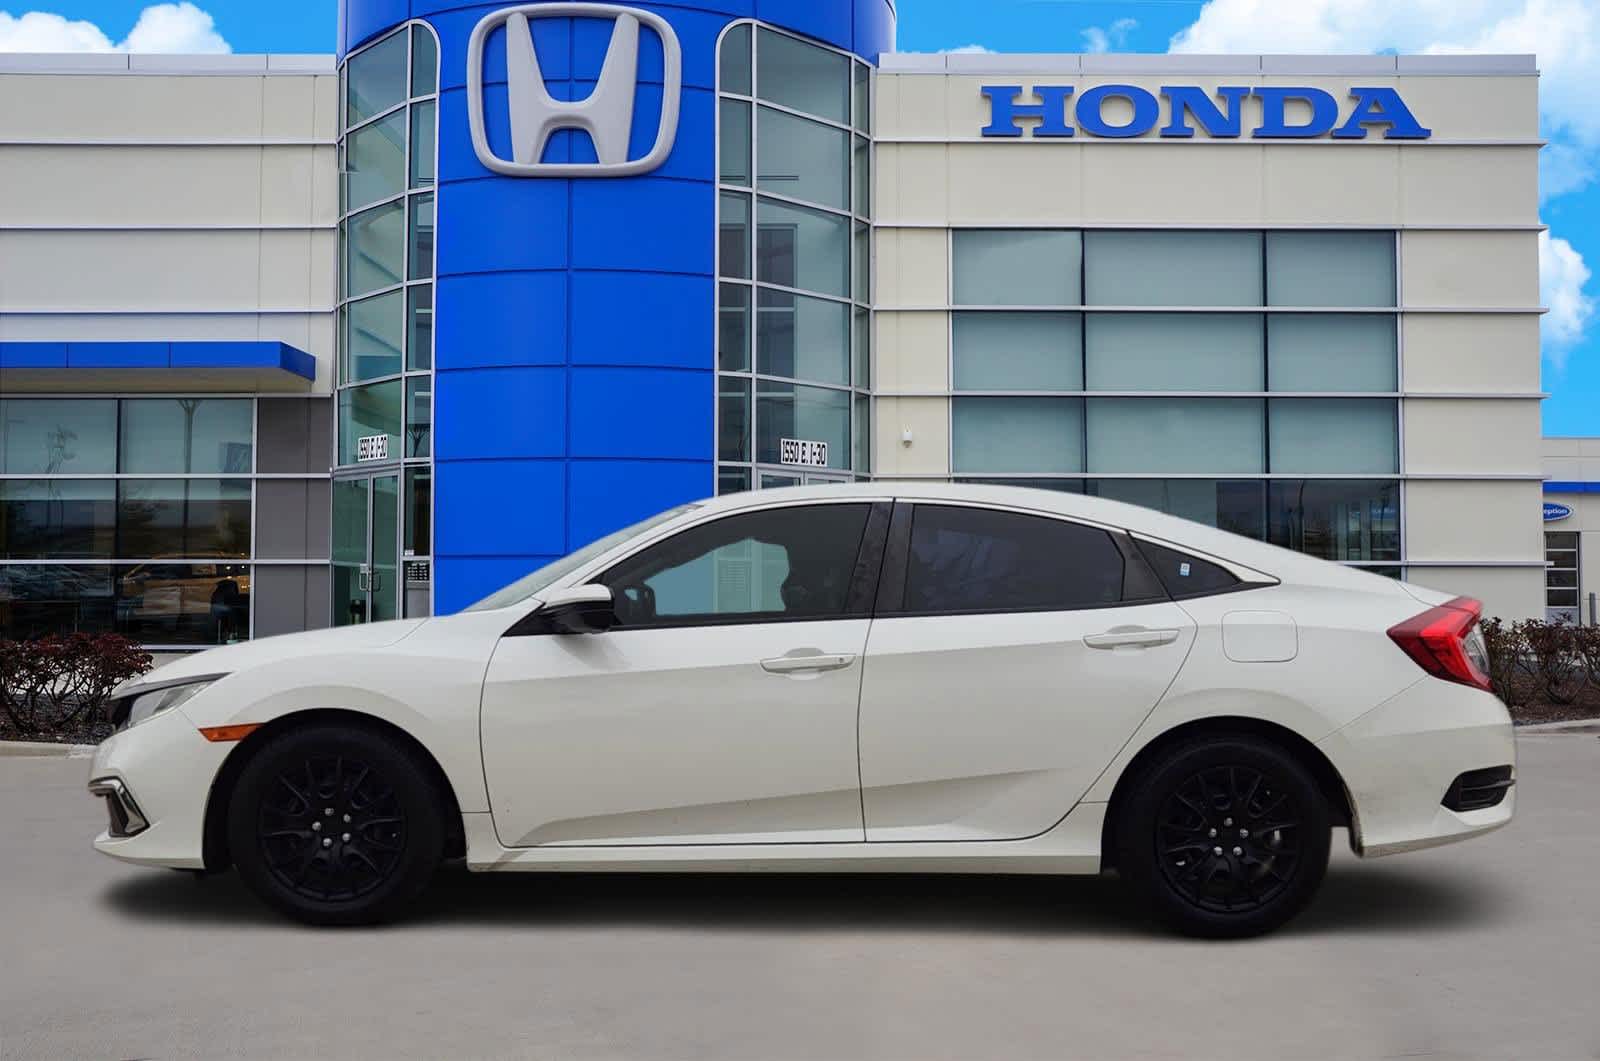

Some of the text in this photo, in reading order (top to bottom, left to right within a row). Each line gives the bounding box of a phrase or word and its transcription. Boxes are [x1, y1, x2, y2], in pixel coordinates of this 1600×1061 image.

[981, 85, 1432, 138] HONDA
[782, 440, 799, 463] 1550
[810, 443, 826, 465] I-30
